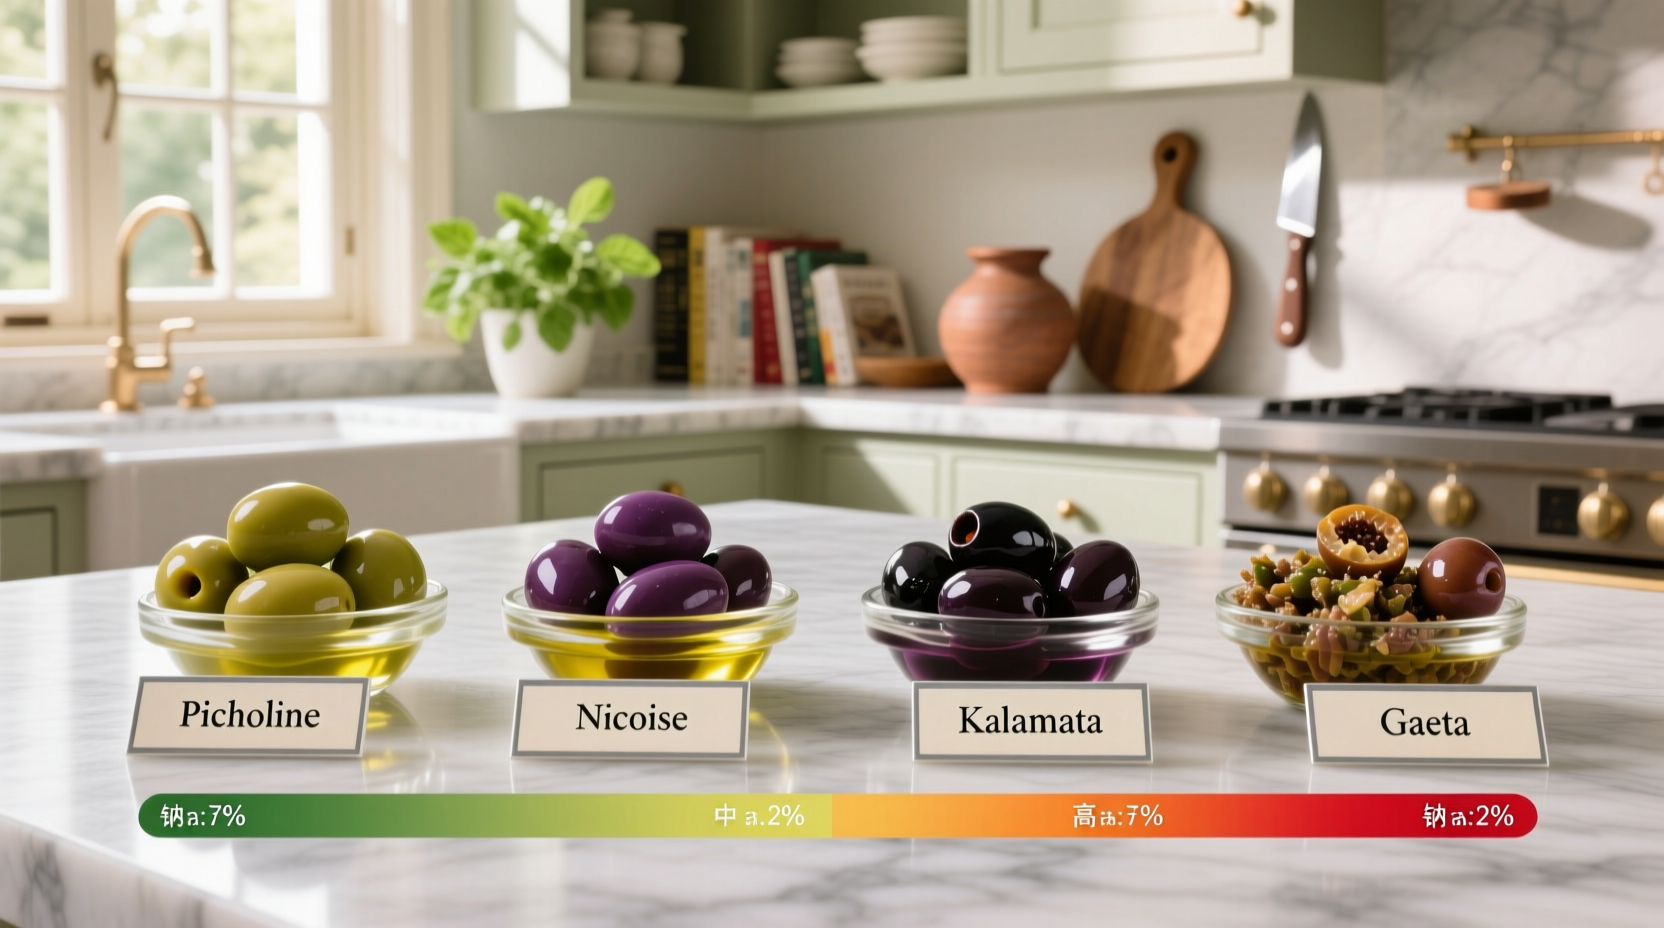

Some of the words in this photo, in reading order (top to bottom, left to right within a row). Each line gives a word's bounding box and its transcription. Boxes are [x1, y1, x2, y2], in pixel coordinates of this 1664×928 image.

[179, 699, 321, 729] Picholine
[575, 703, 689, 731] Nicoise
[958, 705, 1104, 734] Kalamata
[1379, 706, 1472, 737] Gaeta
